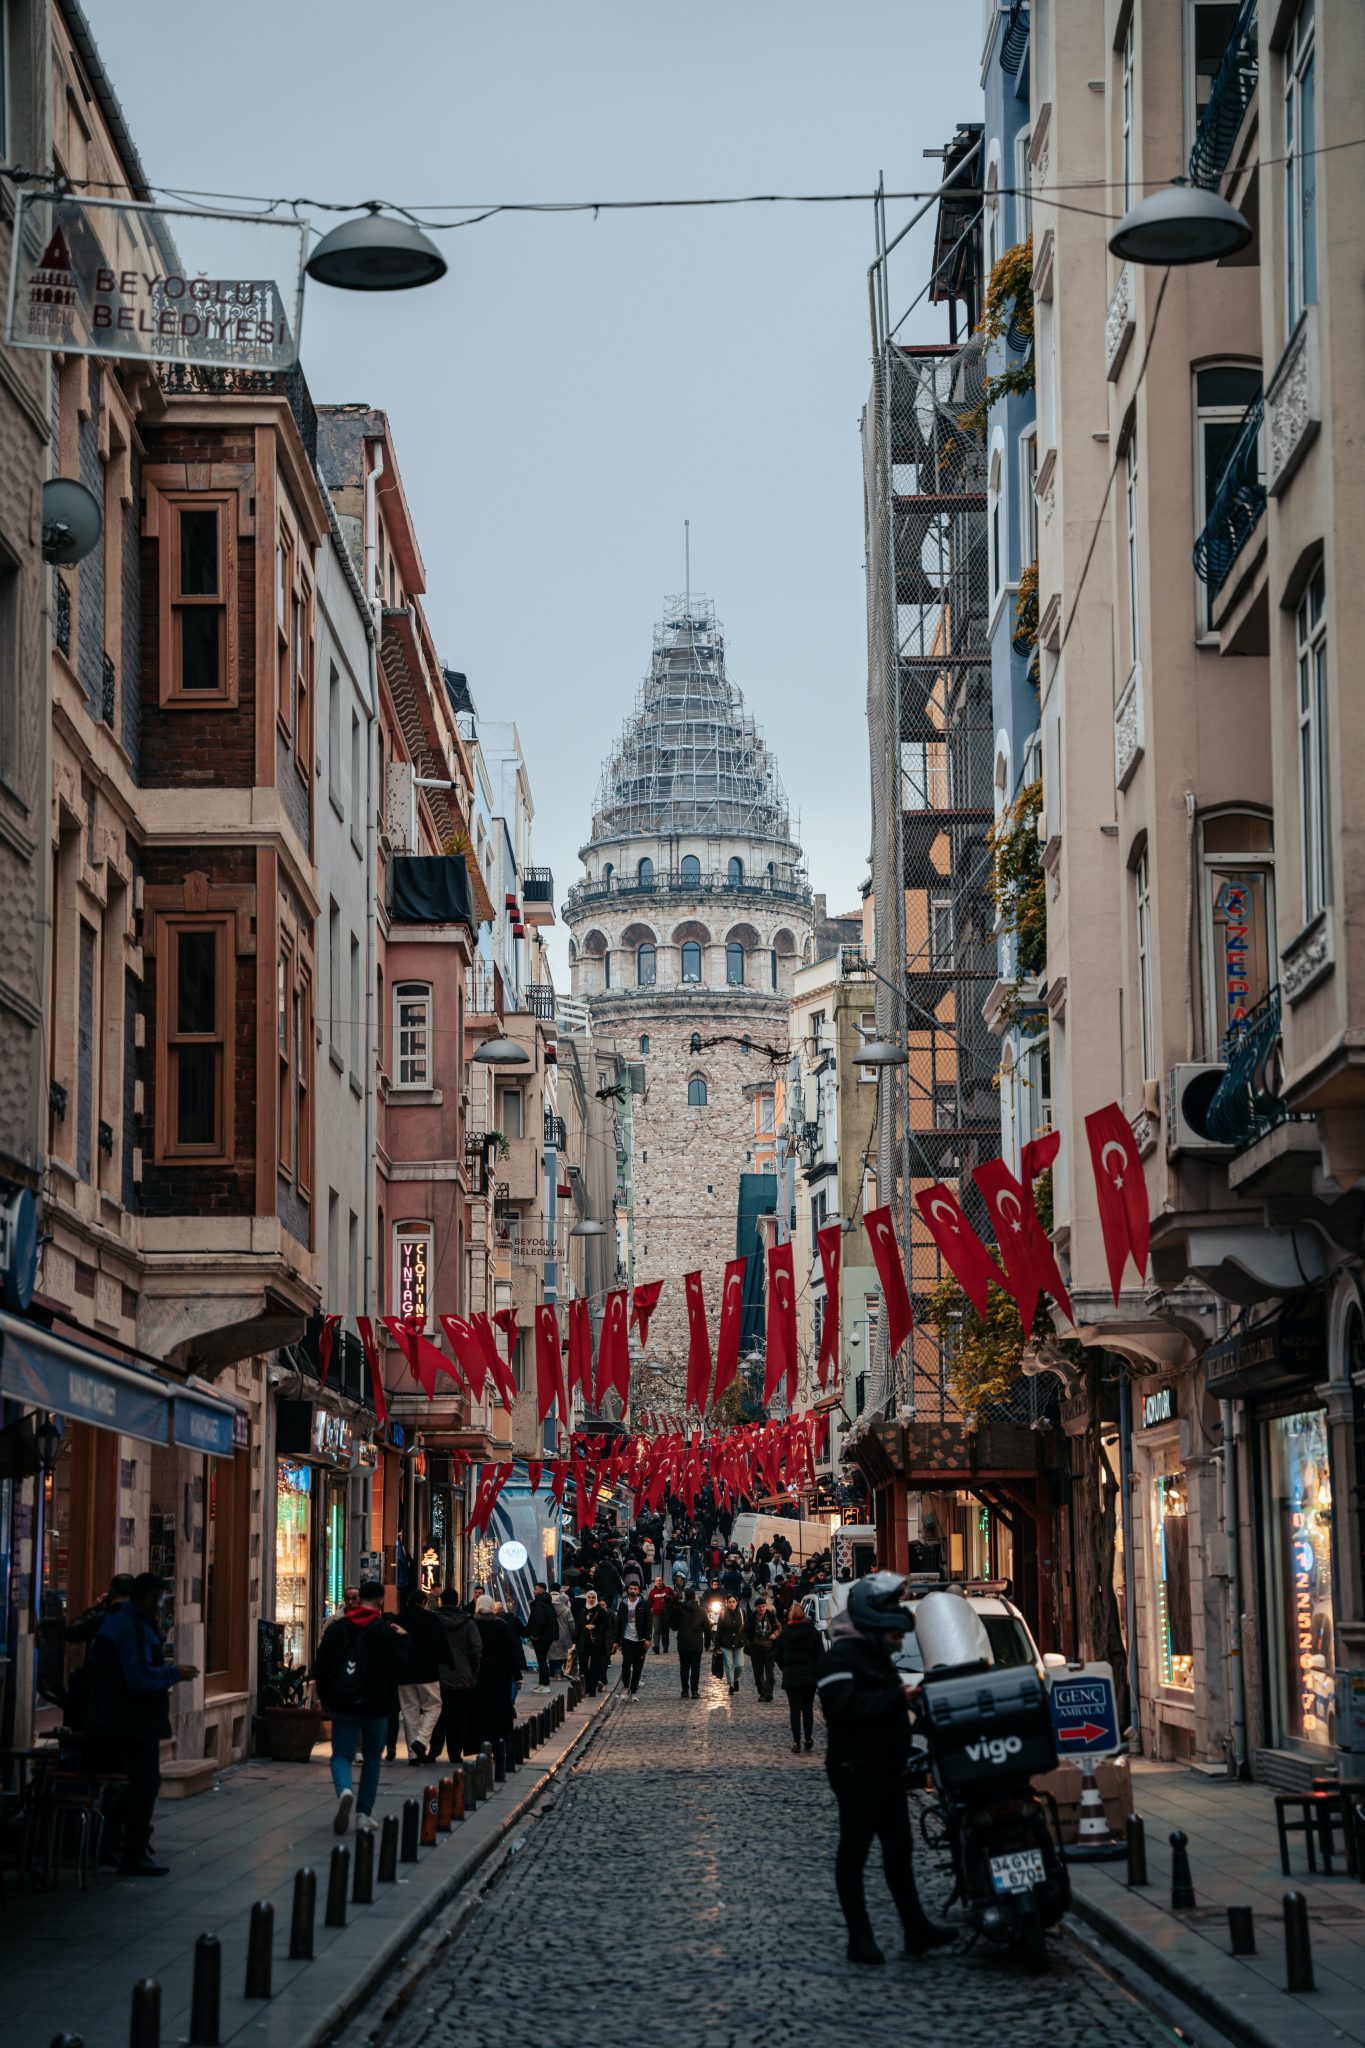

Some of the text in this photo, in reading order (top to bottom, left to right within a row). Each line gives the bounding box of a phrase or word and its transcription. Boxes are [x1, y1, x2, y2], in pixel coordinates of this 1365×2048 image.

[95, 268, 255, 306] BEYOĞLU
[93, 304, 286, 345] BELEDİYESİ
[415, 1243, 425, 1317] CLOTHIN
[1058, 1687, 1101, 1703] GENÇ
[964, 1735, 1022, 1765] vigo
[1009, 1868, 1036, 1885] 670
